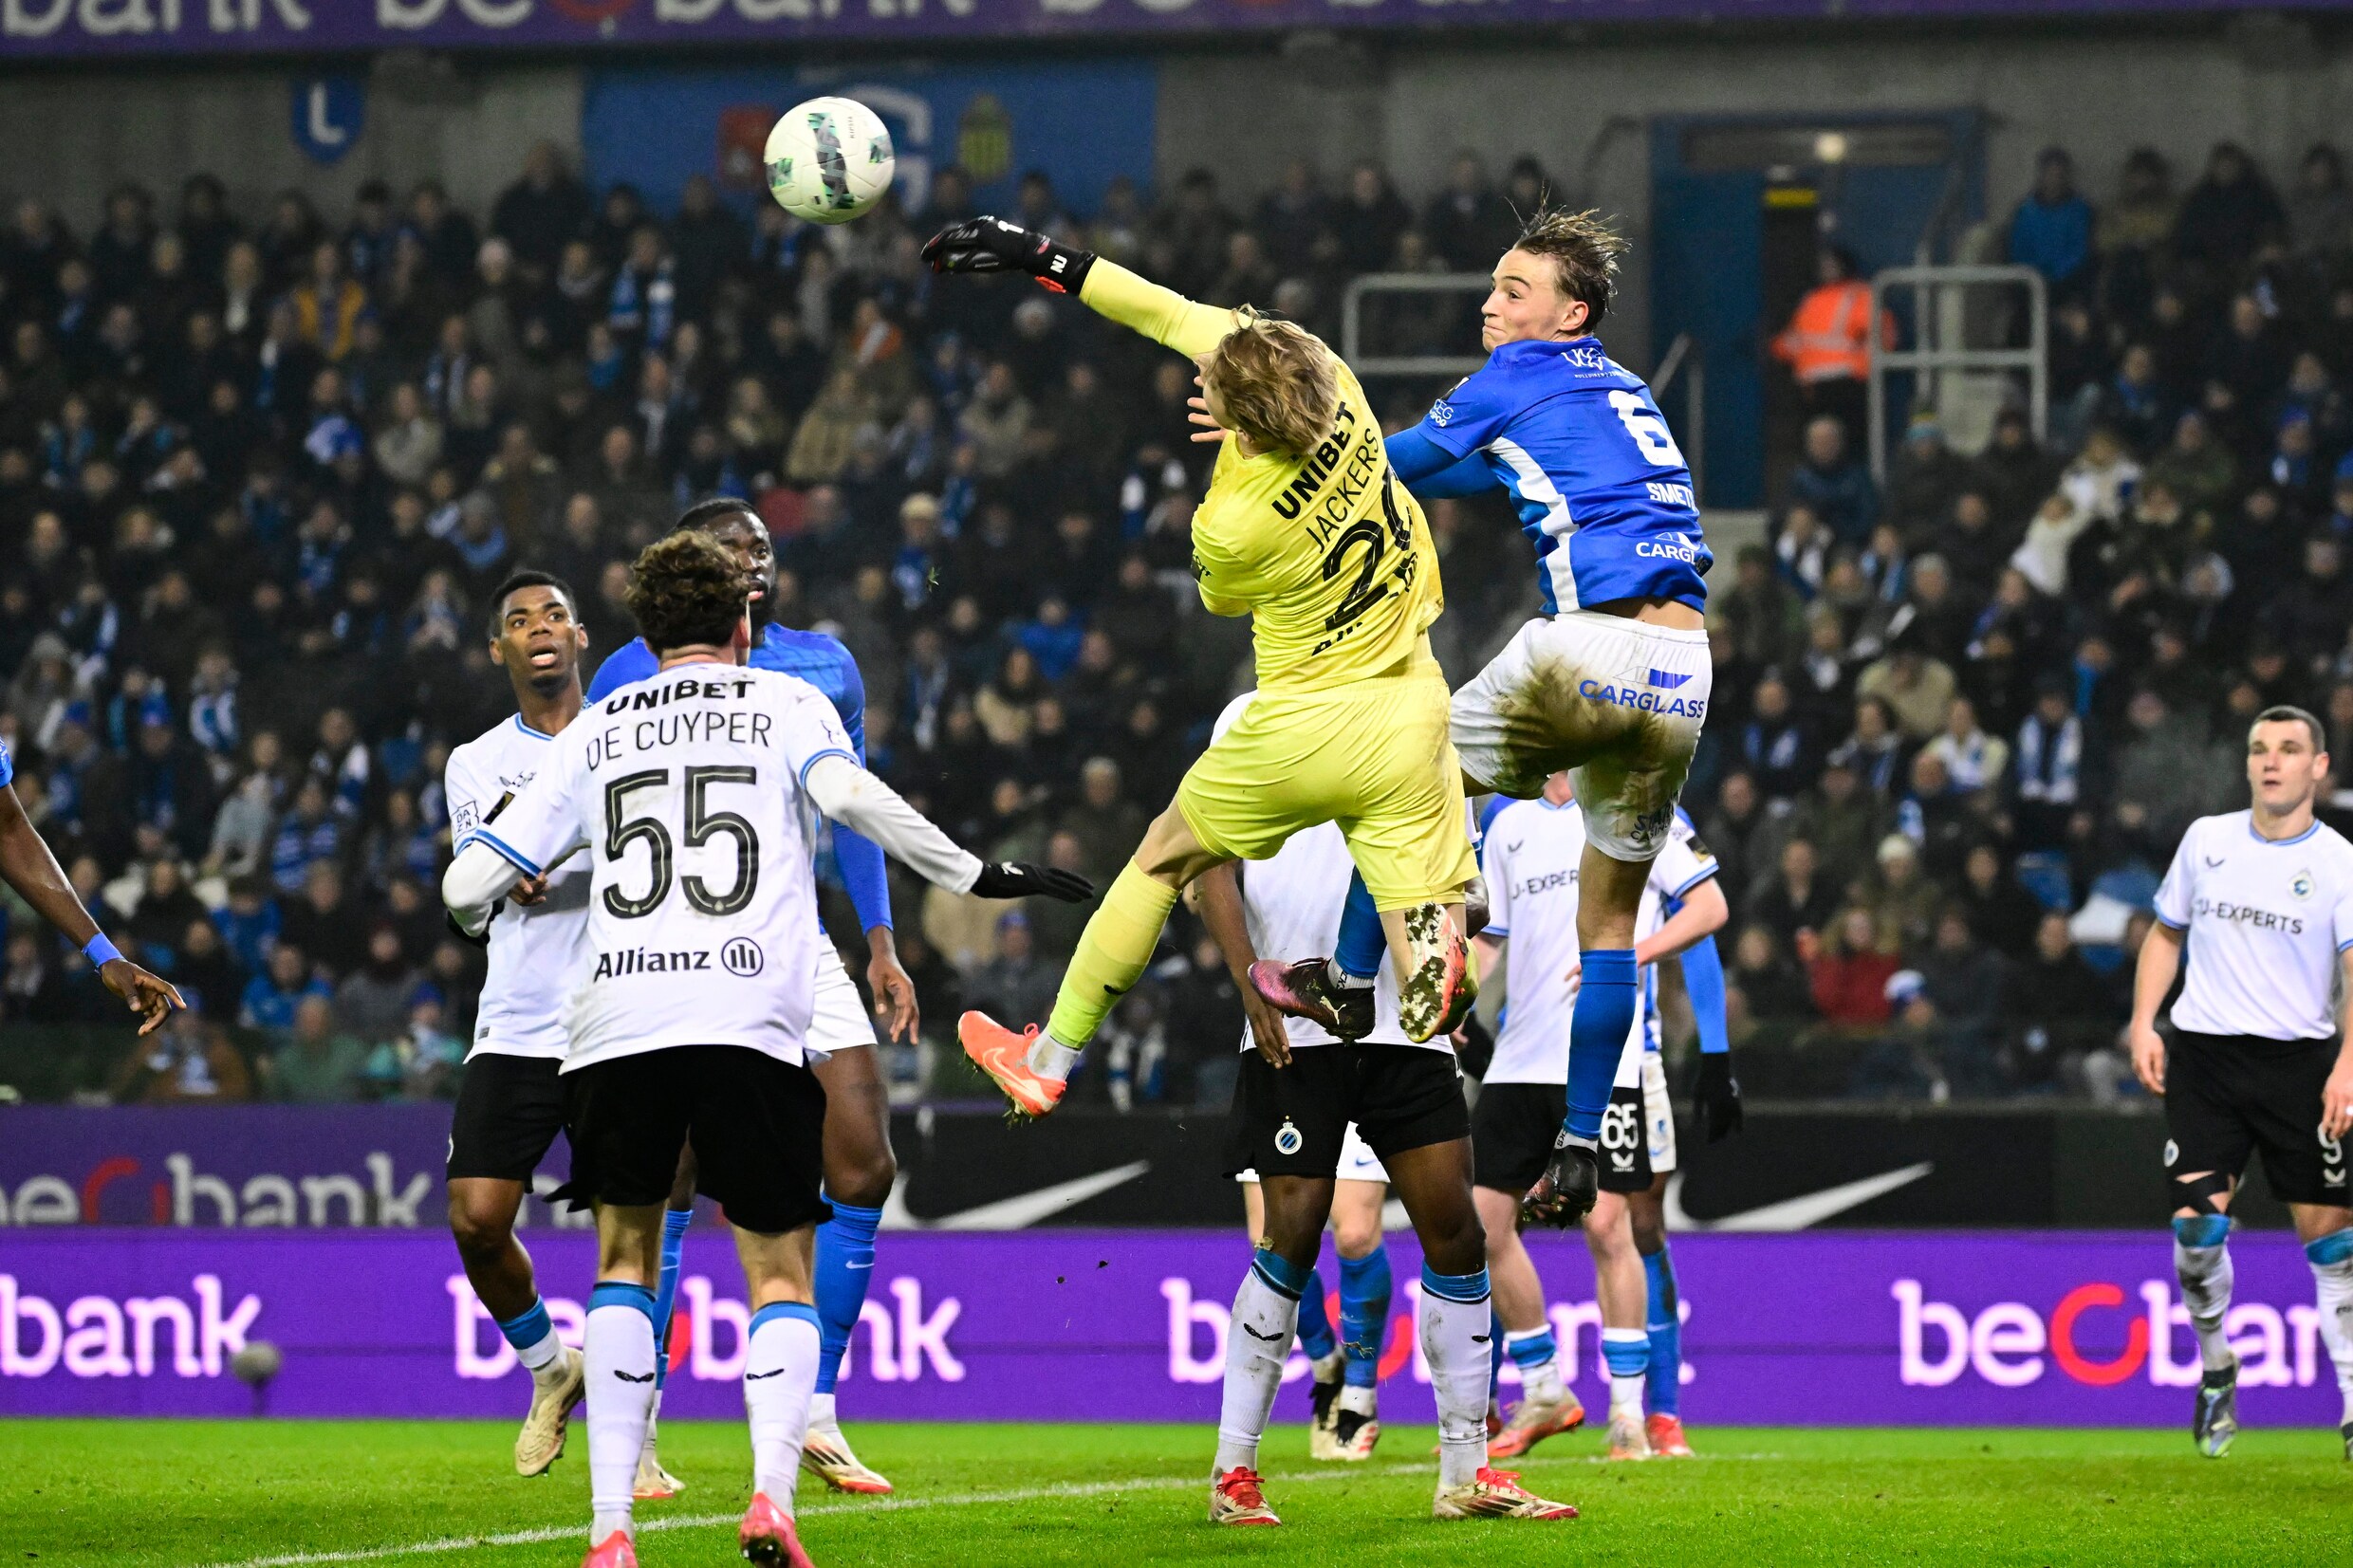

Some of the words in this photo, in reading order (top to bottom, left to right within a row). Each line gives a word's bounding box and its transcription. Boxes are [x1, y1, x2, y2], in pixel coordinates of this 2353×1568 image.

[1271, 401, 1356, 520] UNIBET
[1608, 390, 1683, 467] 6
[1306, 428, 1380, 554] JACKERS
[606, 679, 755, 716] UNIBET
[1579, 678, 1705, 719] CARGLASS
[586, 726, 623, 771] DE
[636, 710, 772, 750] CUYPER
[602, 766, 760, 919] 55
[593, 946, 712, 984] Allianz
[1600, 1102, 1640, 1150] 65
[0, 1152, 433, 1227] eobank
